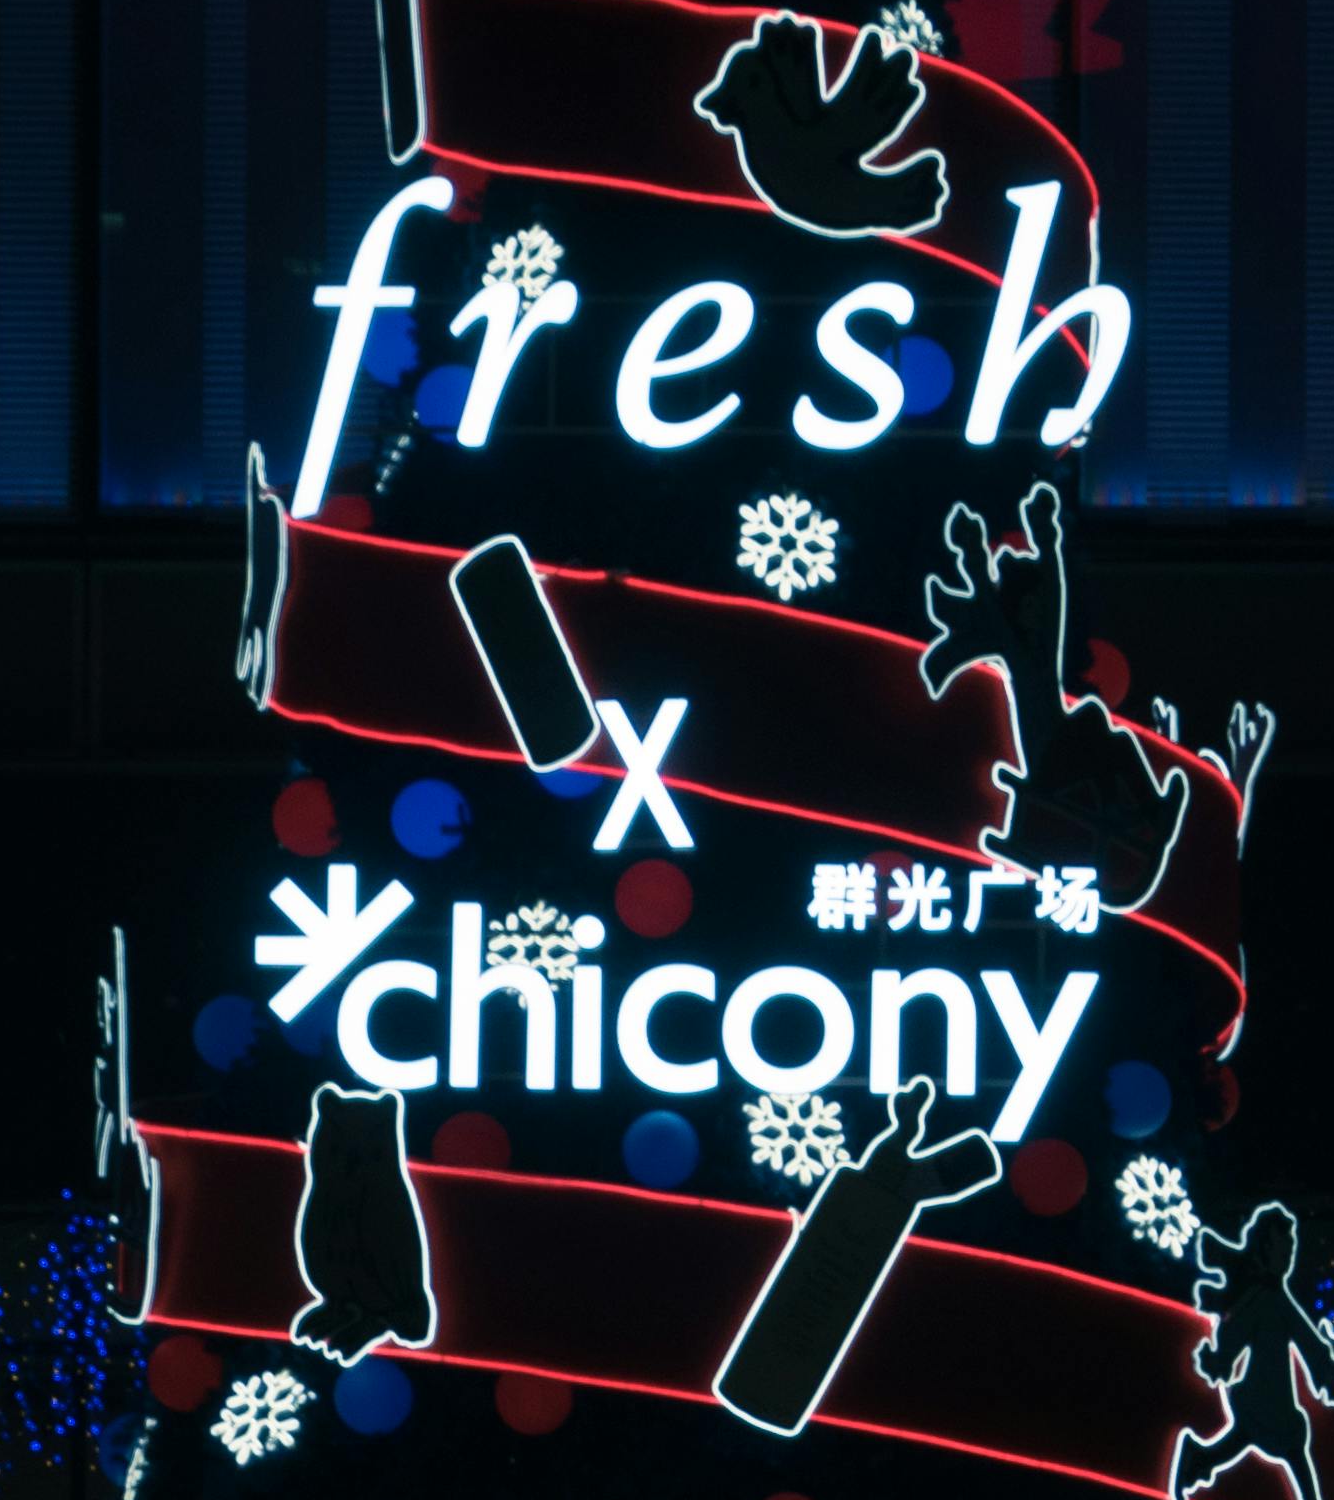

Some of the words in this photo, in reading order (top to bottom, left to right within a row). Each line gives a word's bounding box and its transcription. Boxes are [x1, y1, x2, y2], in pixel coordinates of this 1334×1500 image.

[290, 176, 1133, 520] fresh
[808, 863, 1100, 934] 群光广场
[336, 901, 1100, 1143] chicony
